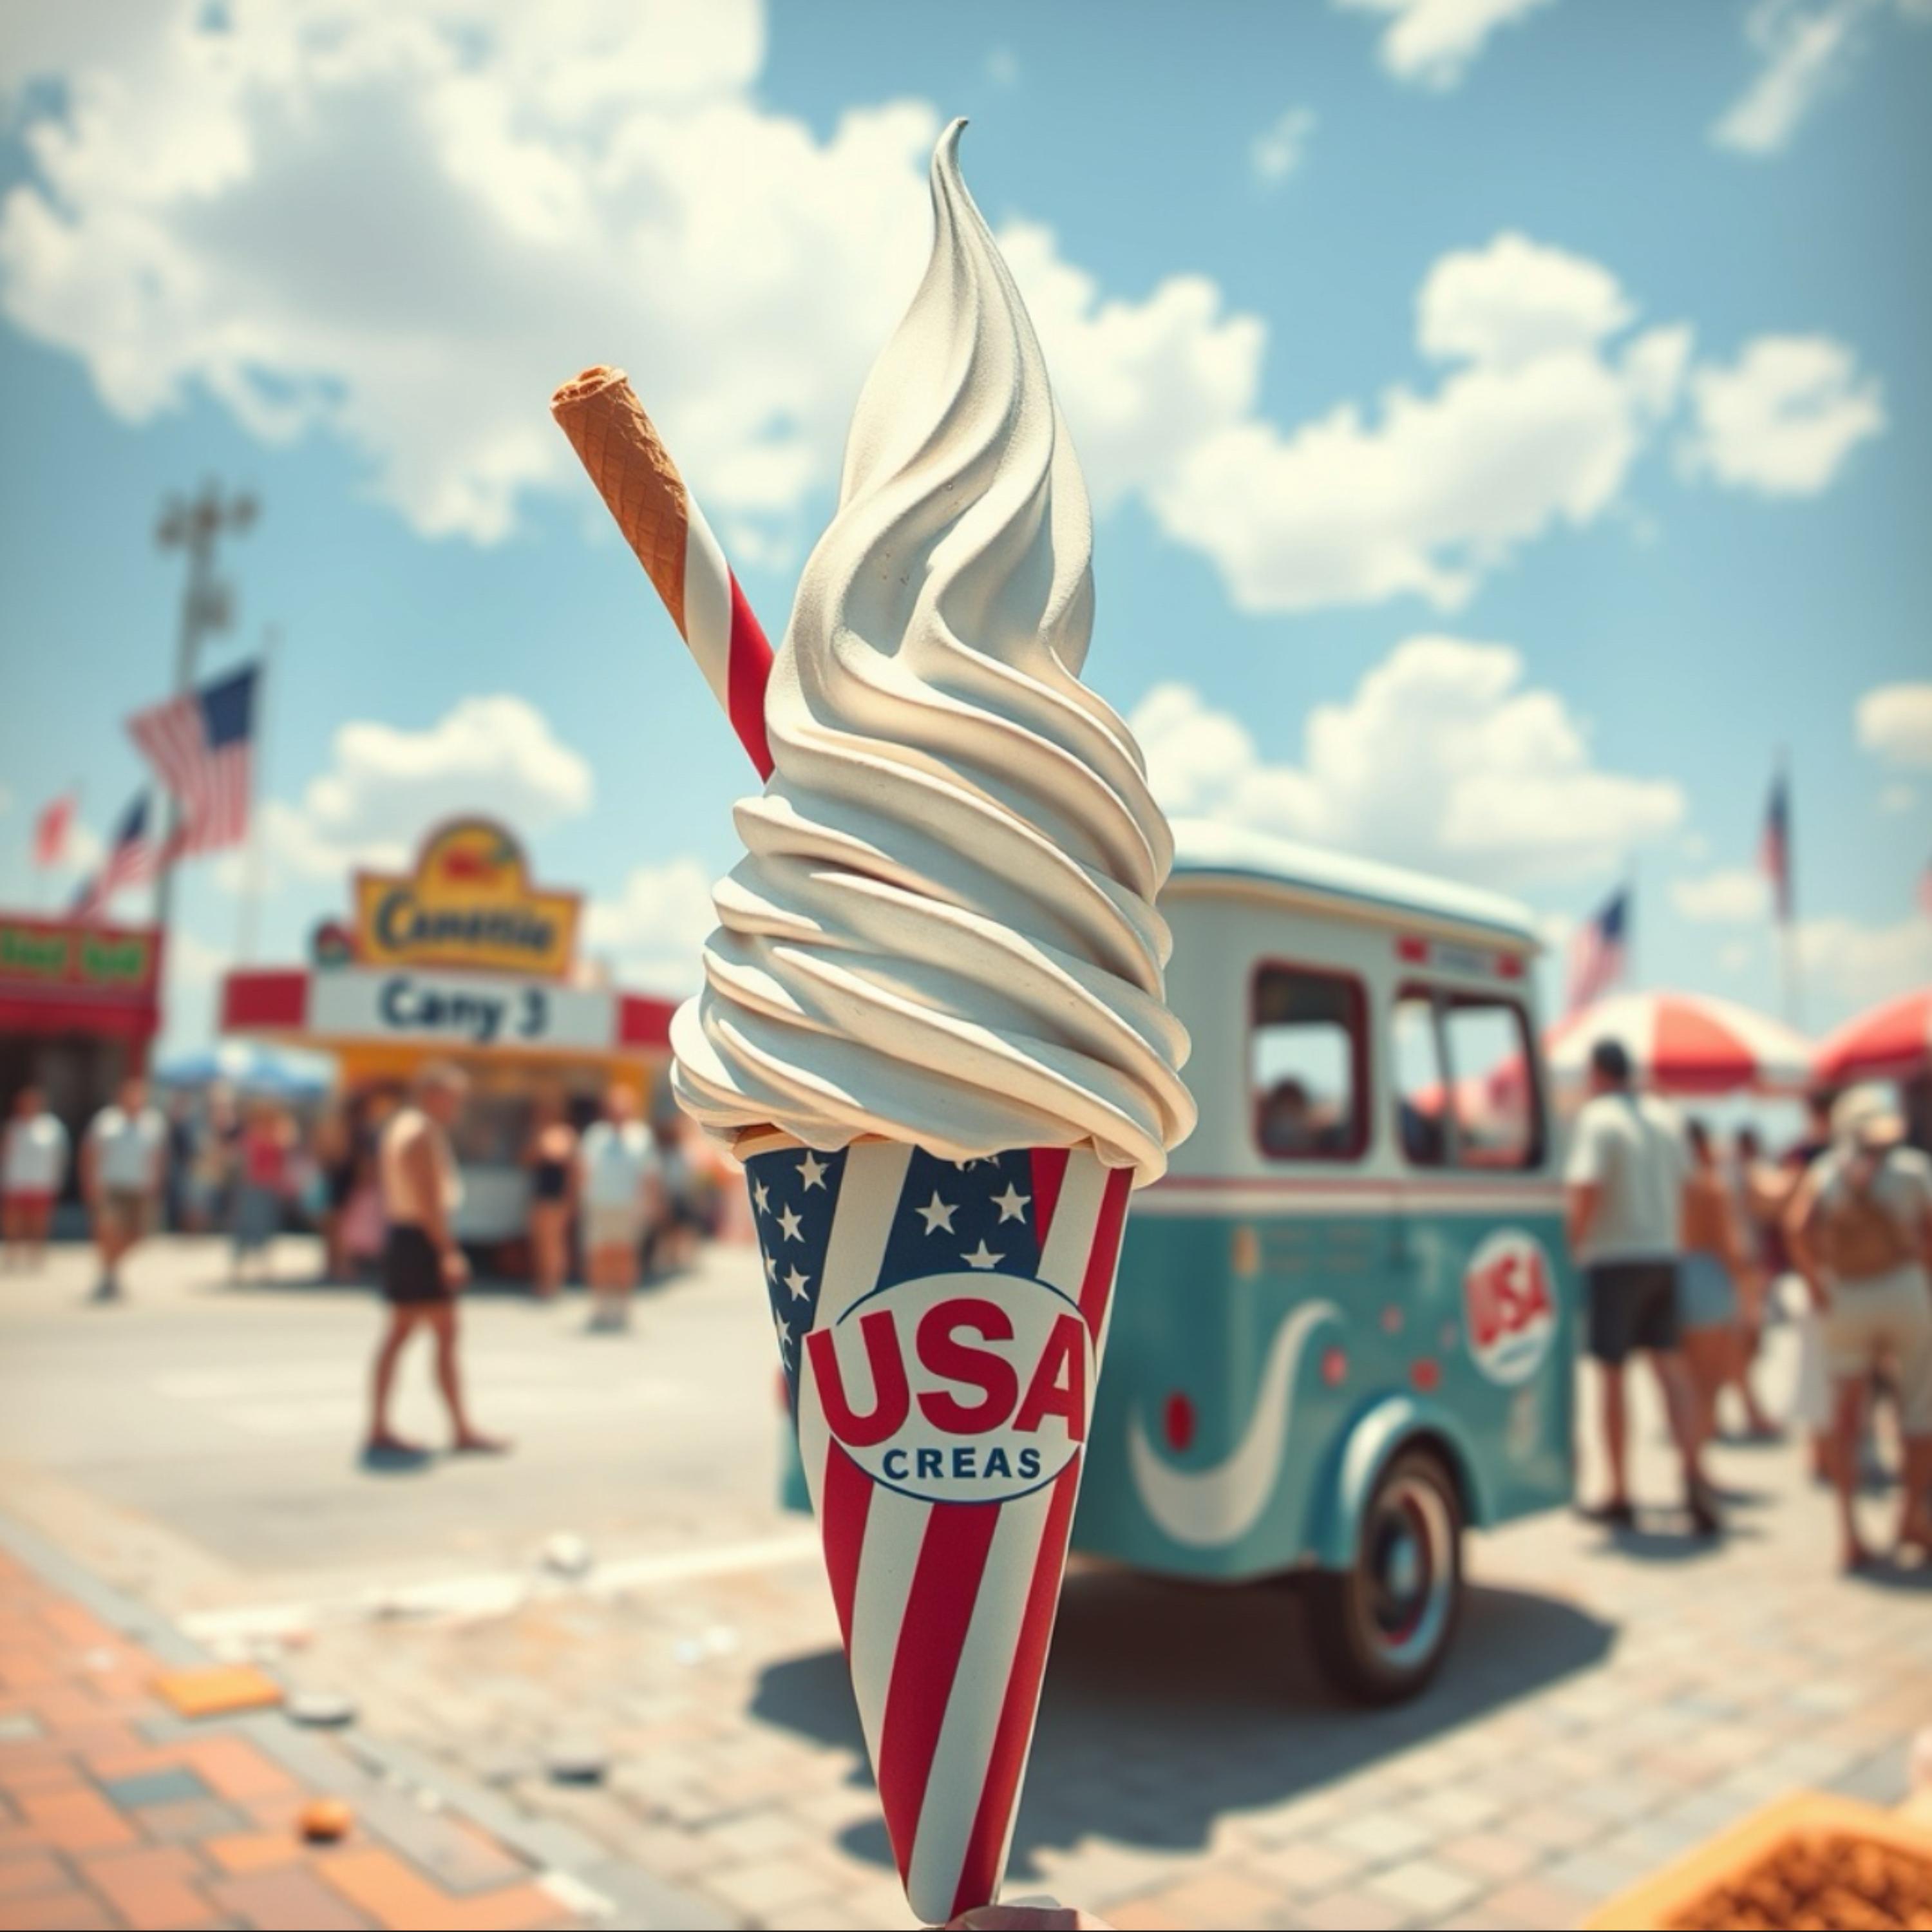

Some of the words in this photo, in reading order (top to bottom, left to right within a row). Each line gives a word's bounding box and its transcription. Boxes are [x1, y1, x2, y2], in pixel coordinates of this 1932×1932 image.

[379, 975, 504, 1046] Cany
[806, 1298, 1086, 1448] USA
[882, 1446, 1041, 1480] CREAS
